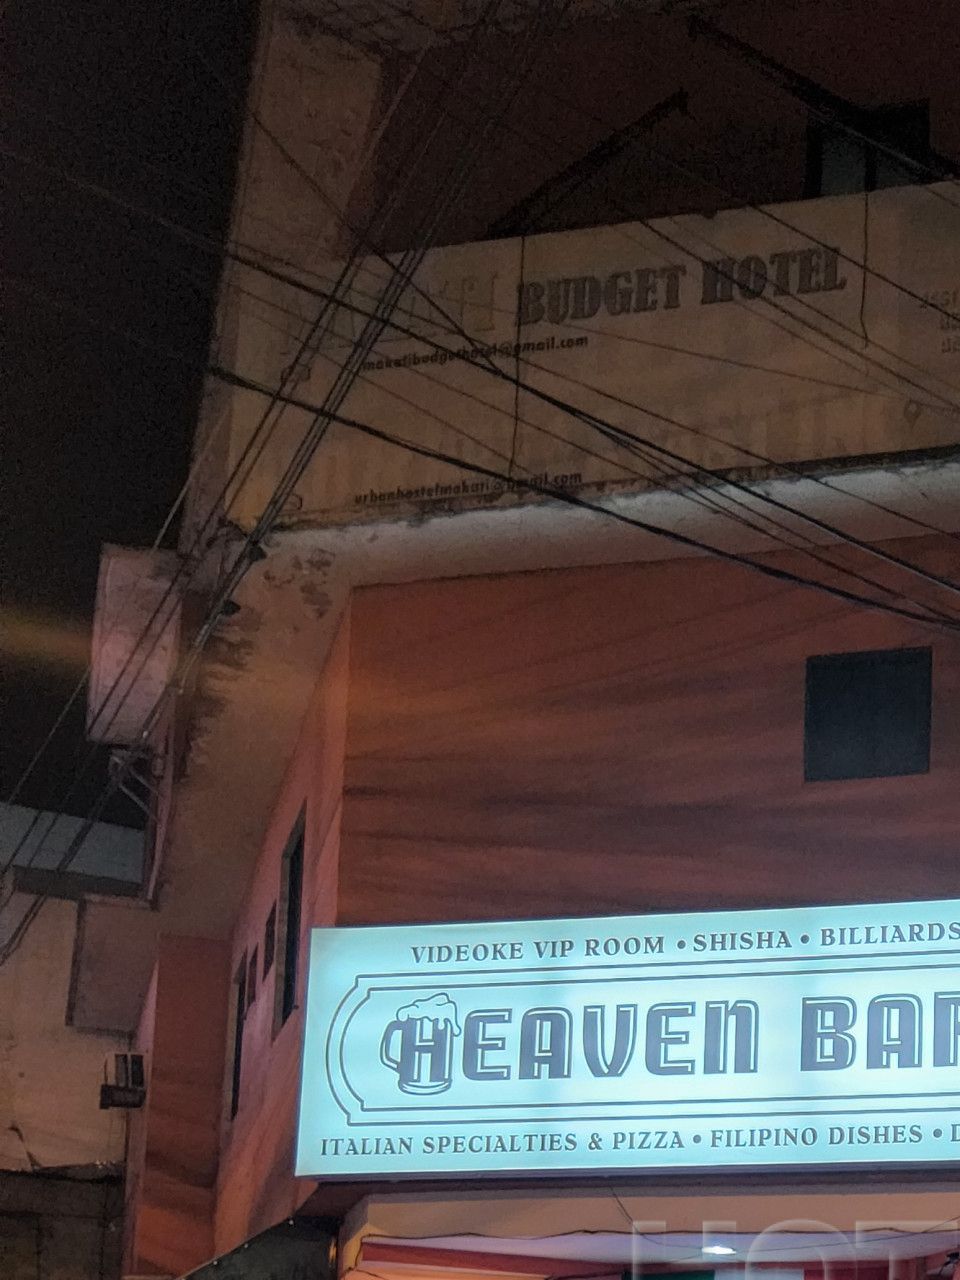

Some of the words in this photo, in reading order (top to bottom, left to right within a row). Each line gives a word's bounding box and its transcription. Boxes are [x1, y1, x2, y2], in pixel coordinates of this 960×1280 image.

[517, 264, 687, 326] BUDGET
[702, 247, 848, 305] HOTEL
[411, 942, 523, 963] VIDEOKE
[533, 940, 574, 959] VIP
[584, 936, 665, 957] ROOM
[693, 931, 792, 952] SHISHA
[398, 999, 760, 1085] HEAVEN
[320, 1137, 414, 1156] ITALIAN
[422, 1133, 578, 1154] SPECIALTIES
[588, 1135, 602, 1151] &
[612, 1131, 684, 1151] PIZZA
[710, 1127, 818, 1148] FILIPINO
[828, 1124, 922, 1146] DISHES
